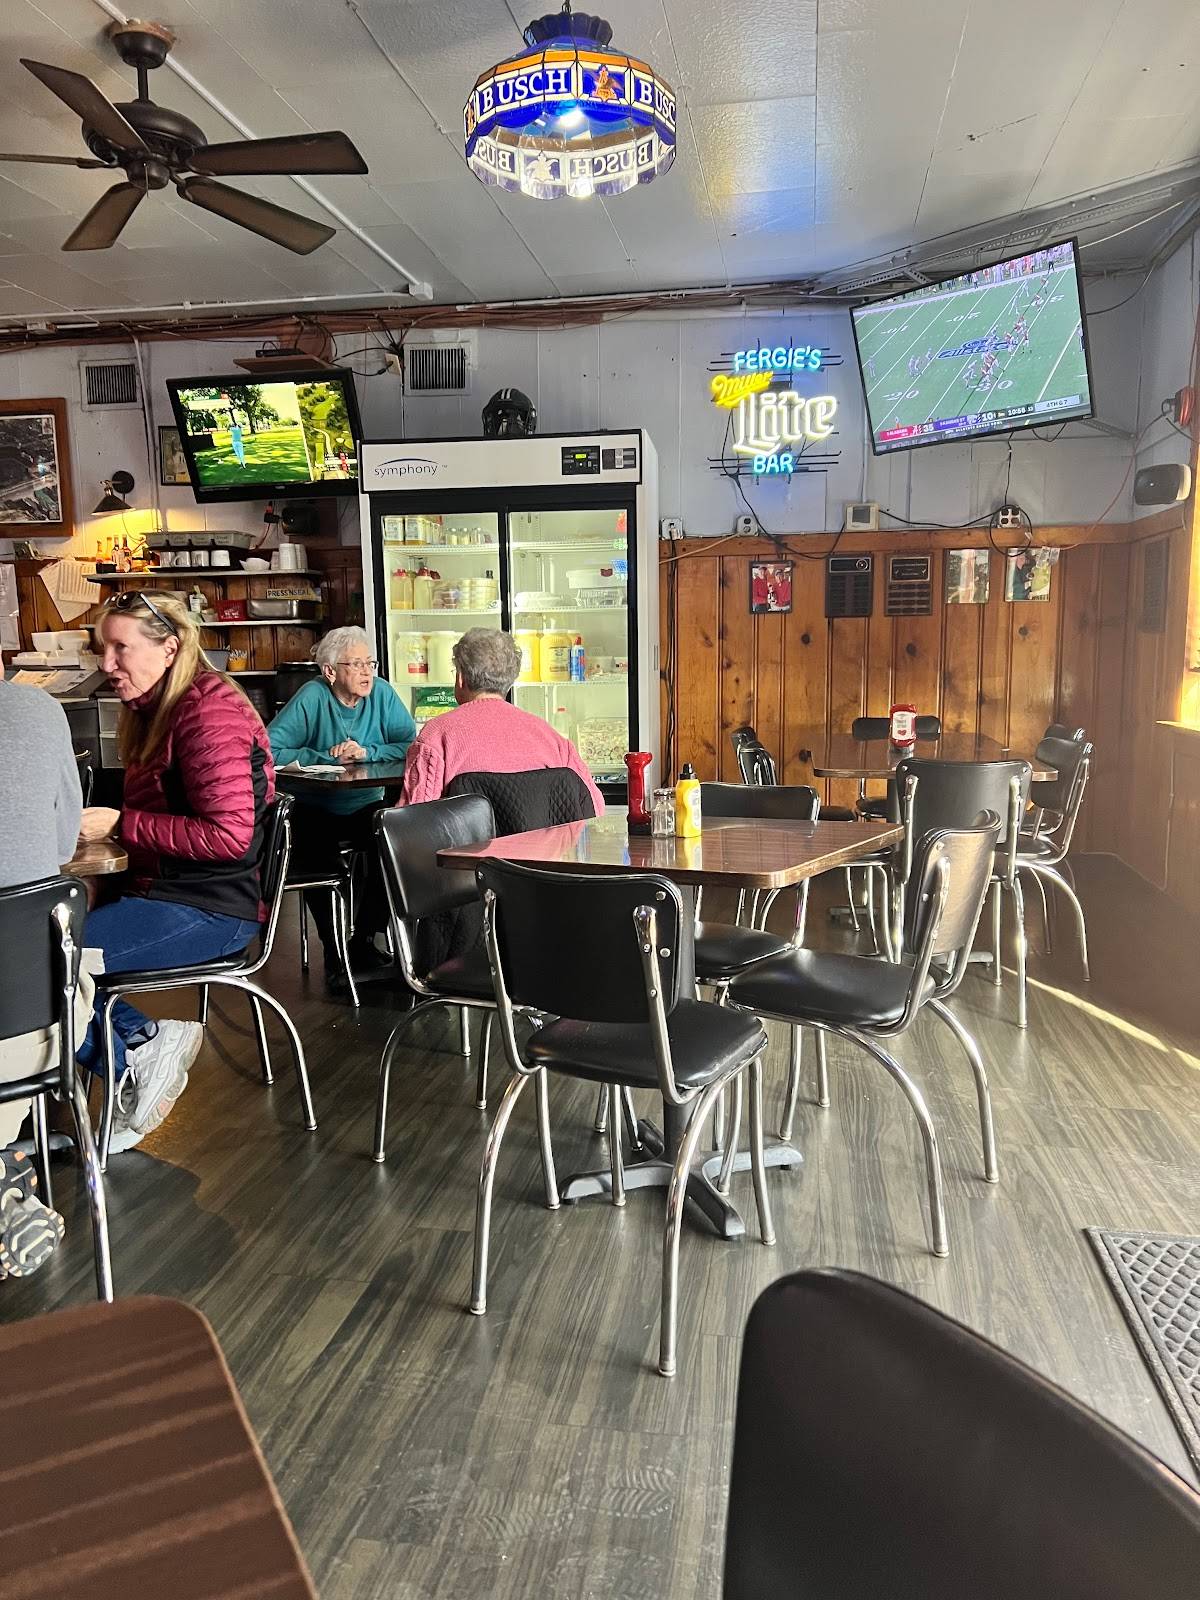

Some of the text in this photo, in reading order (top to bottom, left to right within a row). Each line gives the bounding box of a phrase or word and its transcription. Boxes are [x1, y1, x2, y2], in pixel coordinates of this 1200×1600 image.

[482, 68, 569, 112] BUSCH
[733, 346, 822, 372] FERGIE'S
[711, 371, 774, 408] Miller
[732, 391, 838, 456] Lite
[923, 424, 934, 432] 35
[982, 412, 993, 421] 10
[374, 463, 438, 478] symphony
[753, 453, 794, 473] BAR
